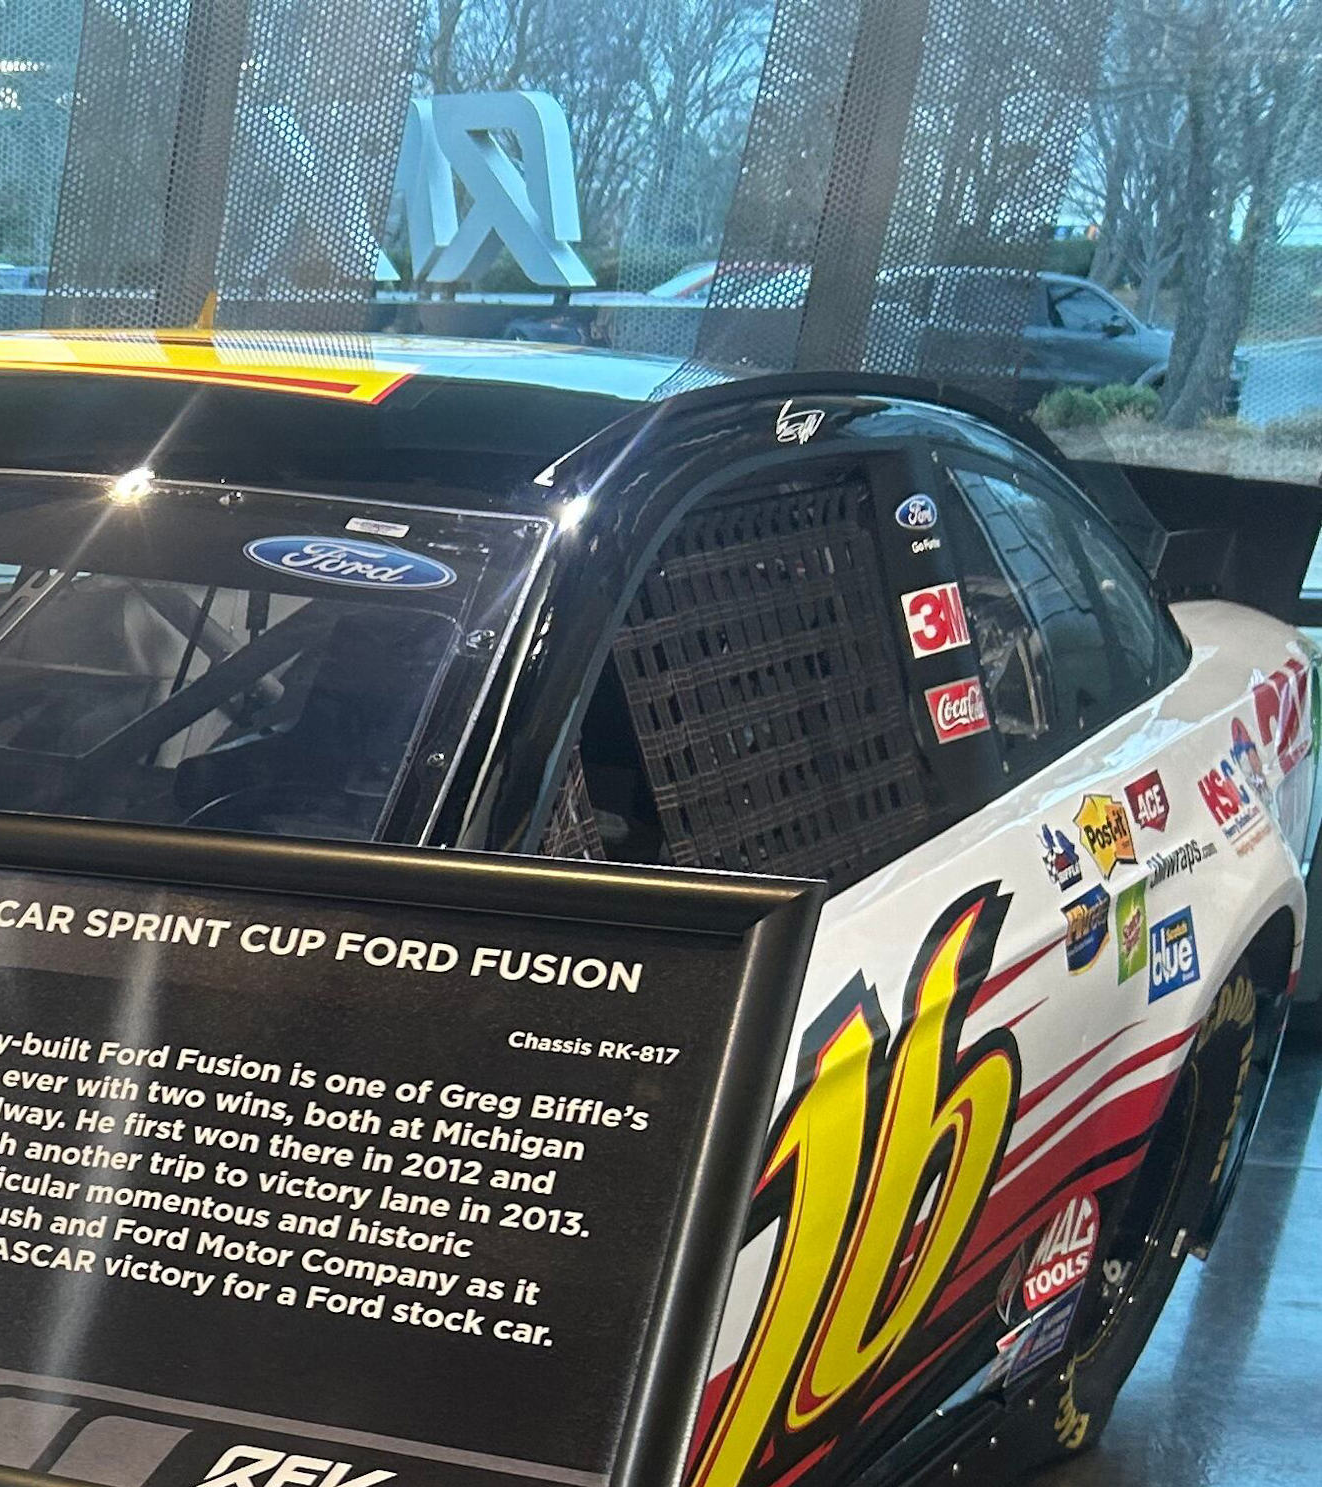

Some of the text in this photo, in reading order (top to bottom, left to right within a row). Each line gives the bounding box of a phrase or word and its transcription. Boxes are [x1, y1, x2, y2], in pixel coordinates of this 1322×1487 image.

[281, 543, 414, 582] Ford
[909, 587, 969, 651] 3M
[1083, 810, 1128, 854] Post-it
[1138, 785, 1166, 825] ACE
[83, 908, 231, 947] SPRINT
[240, 923, 326, 956] CUP
[334, 932, 458, 972] FORD
[470, 947, 642, 992] FUSION
[1152, 928, 1193, 987] blue
[98, 1041, 170, 1067] Ford
[175, 1048, 281, 1083] Fusion
[289, 1062, 316, 1088] is
[324, 1074, 386, 1098] one
[394, 1079, 433, 1103] of
[439, 1083, 521, 1119] Greg
[508, 1030, 680, 1064] Chassis RK-817
[2, 1069, 68, 1093] ever
[76, 1075, 138, 1100] with
[148, 1081, 205, 1107] two
[216, 1090, 293, 1126] wins,
[303, 1101, 381, 1134] both
[389, 1117, 424, 1140] at
[432, 1119, 584, 1160] Michigan
[75, 1108, 115, 1133] He
[123, 1112, 185, 1141] first
[194, 1125, 259, 1152] won
[269, 1134, 354, 1167] there
[361, 1146, 393, 1173] in
[400, 1152, 482, 1184] 2012
[489, 1169, 556, 1194] and
[24, 1141, 142, 1170] another
[149, 1152, 205, 1183] trip
[214, 1161, 248, 1187] to
[258, 1170, 372, 1210] victory
[379, 1185, 450, 1217] lane
[458, 1196, 490, 1223] in
[499, 1203, 589, 1237] 2013.
[85, 1184, 270, 1228] momentous
[277, 1213, 341, 1238] and
[347, 1217, 473, 1257] historic
[49, 1215, 107, 1238] and
[113, 1218, 189, 1250] Ford
[196, 1231, 294, 1267] Motor
[301, 1248, 459, 1296] Company
[465, 1277, 504, 1299] as
[513, 1278, 540, 1305] it
[1028, 1197, 1096, 1274] MAC
[105, 1254, 215, 1296] victory
[221, 1272, 271, 1301] for
[276, 1286, 296, 1305] a
[305, 1285, 385, 1318] Ford
[391, 1301, 484, 1335] stock
[493, 1320, 552, 1346] car.
[1025, 1252, 1088, 1301] TOOLS
